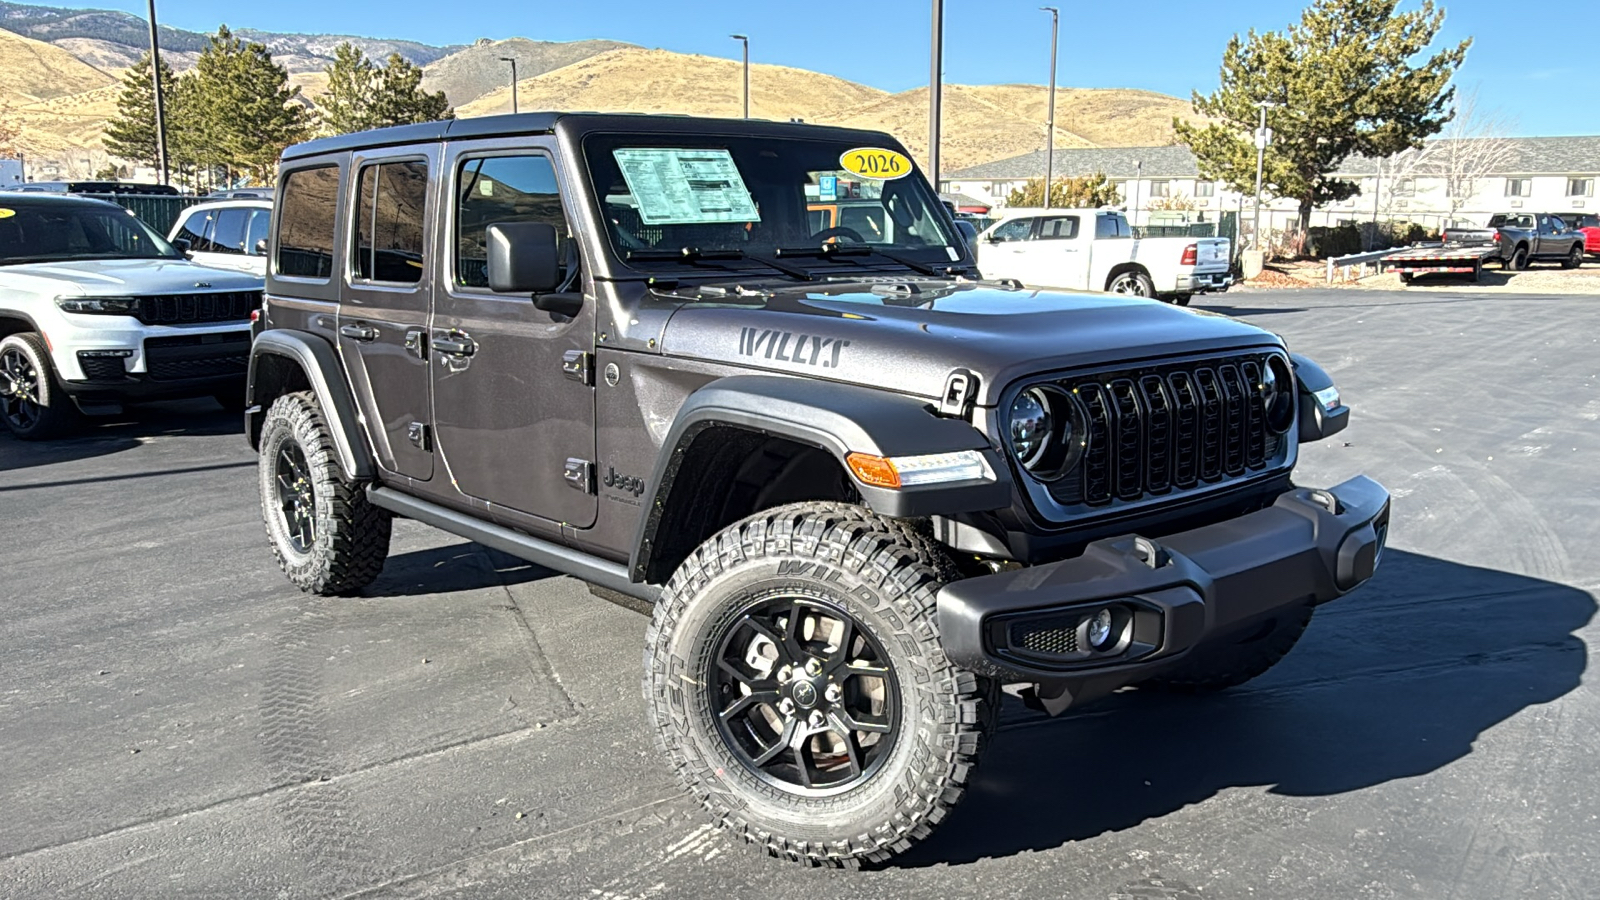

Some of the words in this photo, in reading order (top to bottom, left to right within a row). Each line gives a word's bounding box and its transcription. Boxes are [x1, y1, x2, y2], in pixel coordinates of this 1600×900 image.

[855, 154, 900, 174] 2026
[739, 326, 851, 369] WILLYS
[603, 466, 645, 498] Jeep
[776, 559, 936, 721] WILDPEAK
[668, 653, 751, 814] FALKEN
